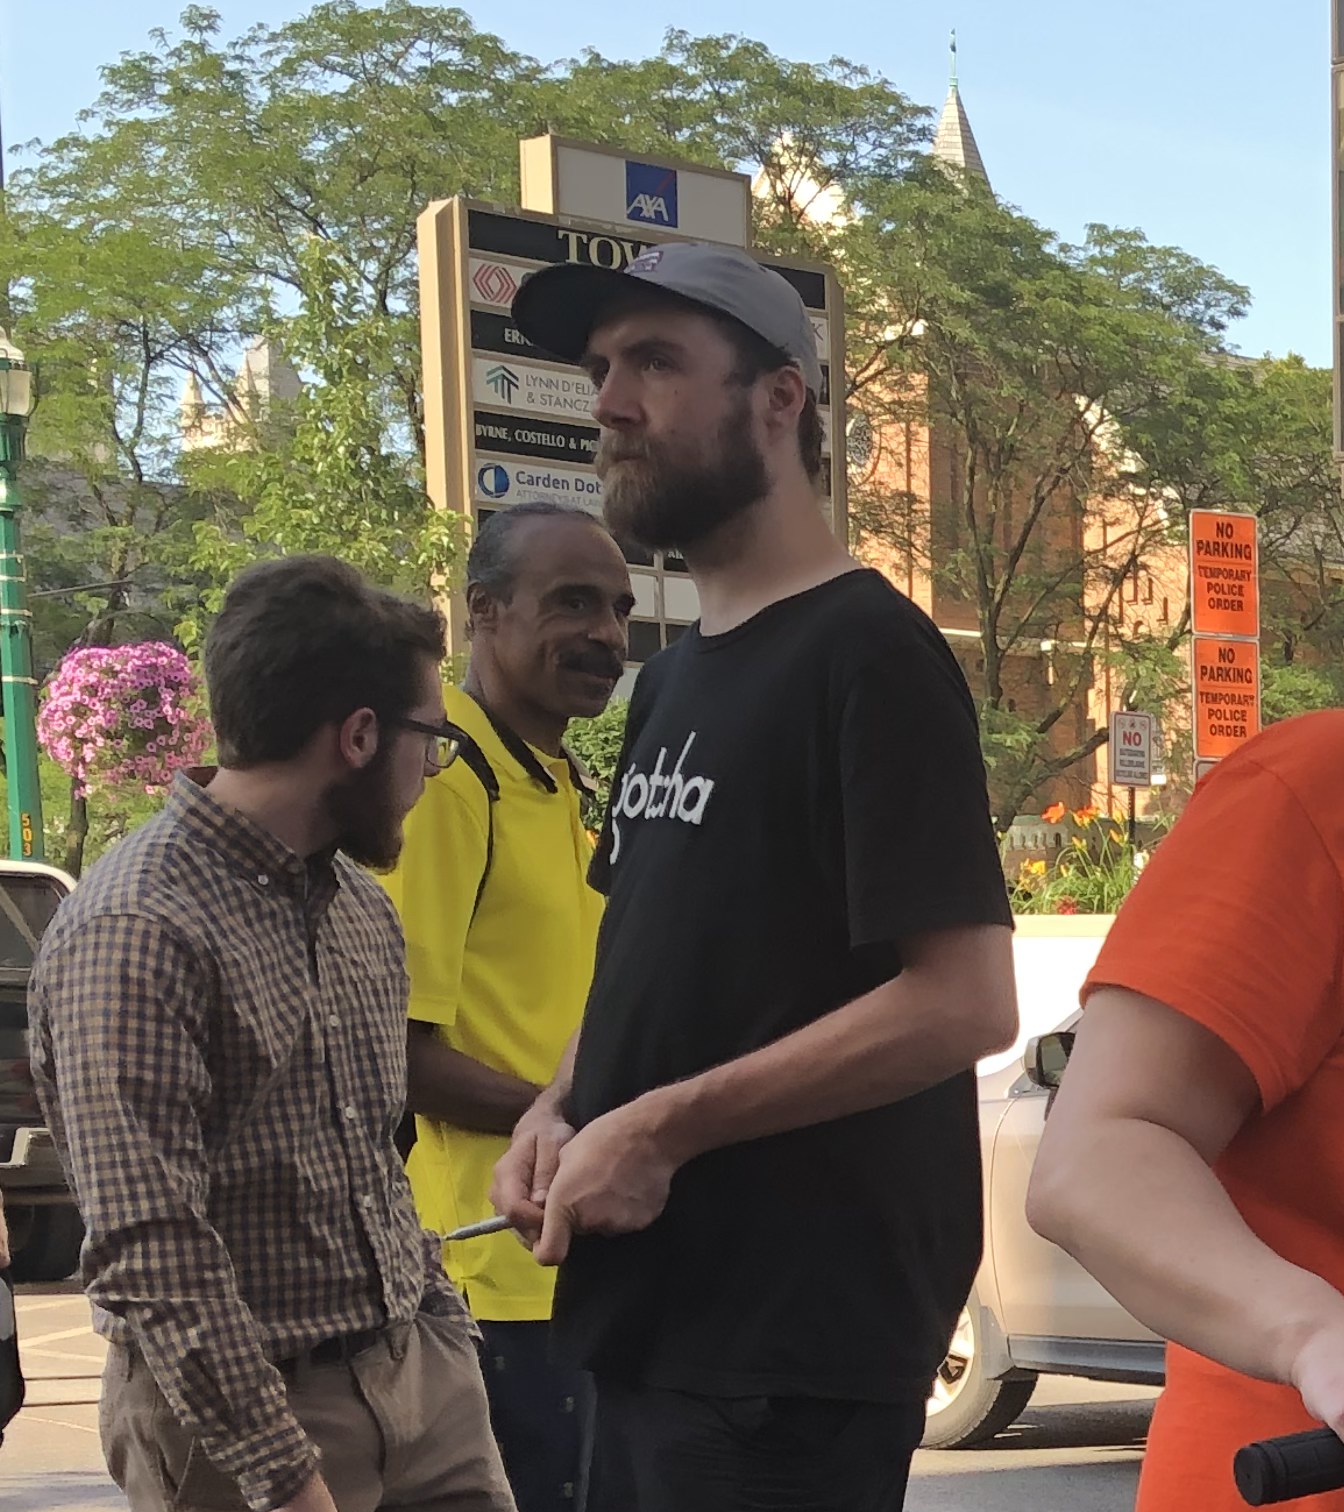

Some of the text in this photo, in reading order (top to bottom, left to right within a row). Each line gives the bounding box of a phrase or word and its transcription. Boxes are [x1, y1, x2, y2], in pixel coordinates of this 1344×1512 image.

[626, 193, 669, 222] AXA
[525, 374, 560, 391] LYNN
[526, 391, 592, 413] & STANCZ
[475, 423, 512, 442] BYRNE,
[514, 429, 566, 448] COSTELLO
[568, 437, 577, 450] &
[515, 470, 570, 491] Carden
[1215, 521, 1234, 539] NO
[1196, 540, 1252, 560] PARKING
[1198, 565, 1252, 582] TEMPORARY
[1206, 581, 1245, 597] POLICE
[1207, 597, 1244, 611] ORDER
[1218, 647, 1235, 664] NO
[1200, 665, 1253, 684] PARKING
[1199, 691, 1255, 706] TEMPORARY
[1207, 708, 1247, 722] POLICE
[1122, 731, 1142, 746] NO
[1209, 724, 1247, 738] ORDER
